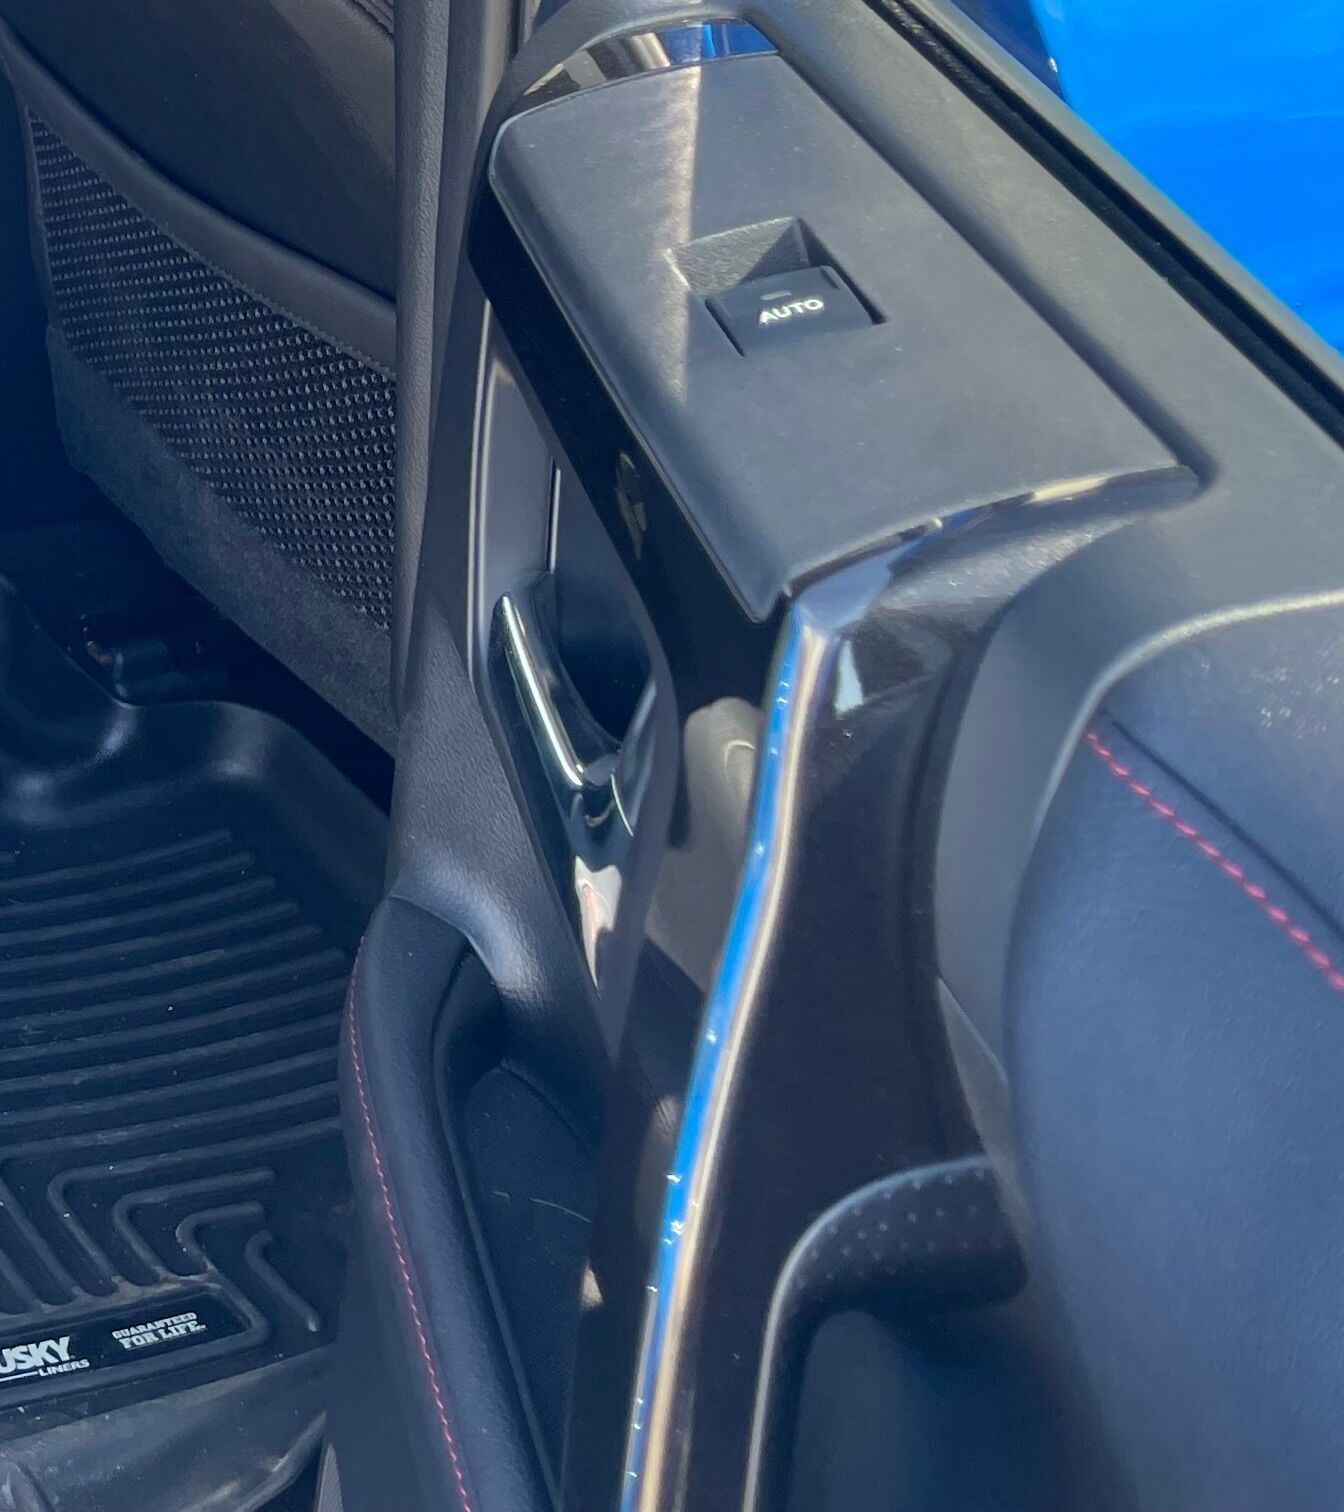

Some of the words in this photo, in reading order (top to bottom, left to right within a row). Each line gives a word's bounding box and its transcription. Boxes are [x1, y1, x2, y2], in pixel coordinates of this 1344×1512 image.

[759, 299, 824, 325] AUTO
[111, 1311, 198, 1340] GUARANTEED
[118, 1331, 160, 1350] FOR
[38, 1359, 90, 1377] LINERS
